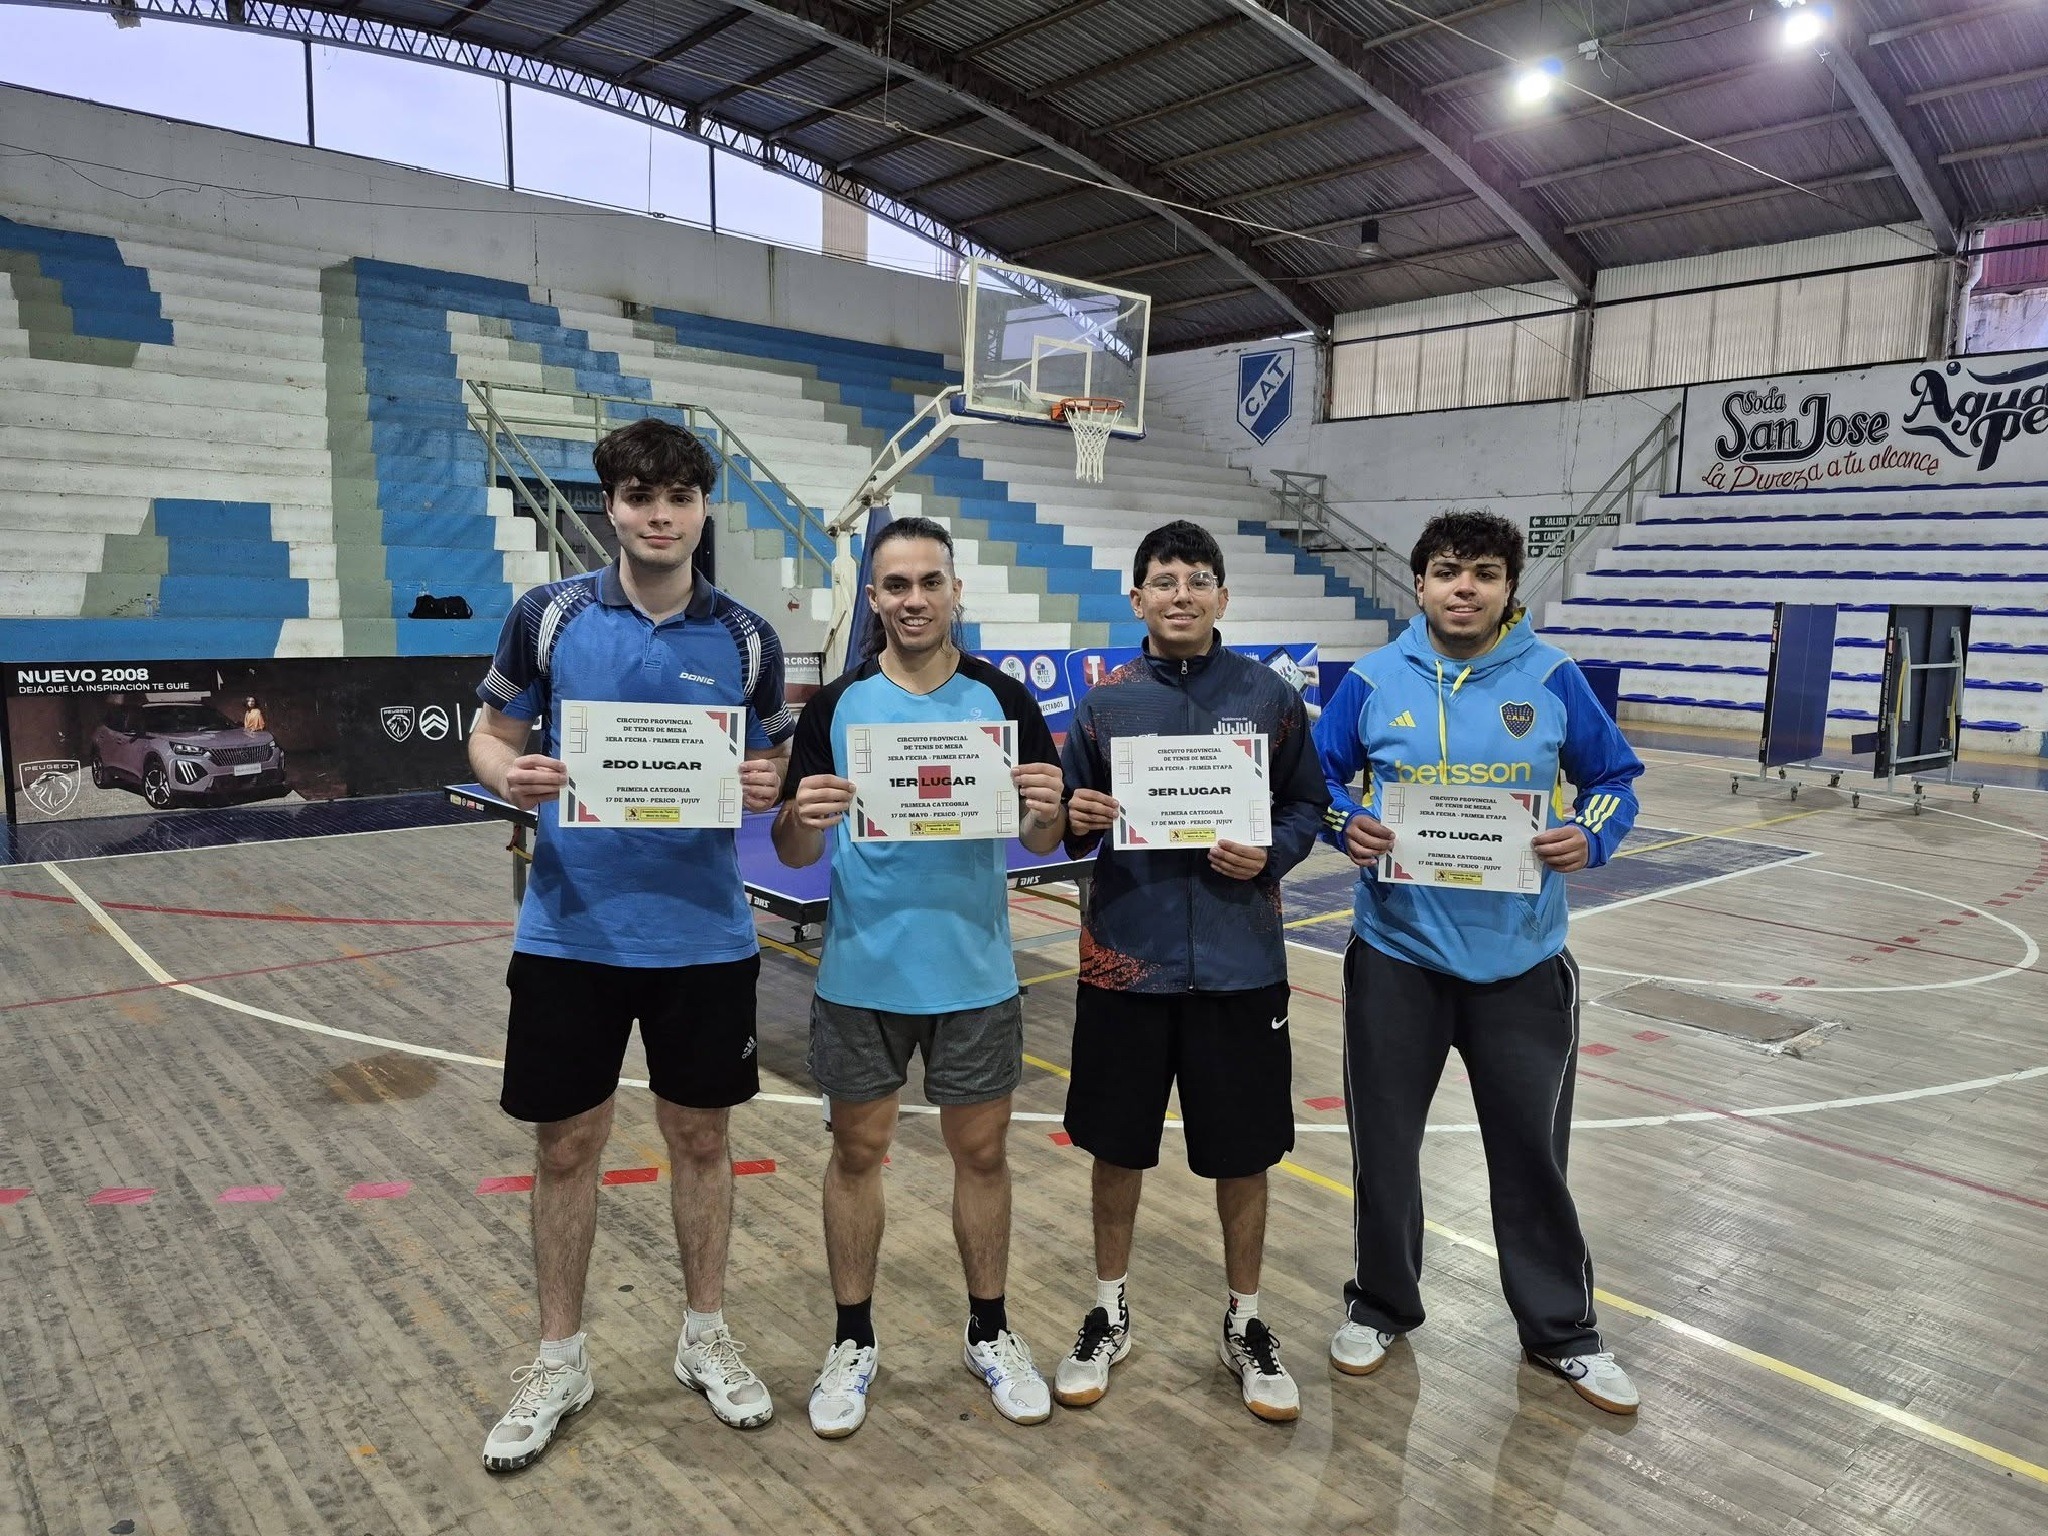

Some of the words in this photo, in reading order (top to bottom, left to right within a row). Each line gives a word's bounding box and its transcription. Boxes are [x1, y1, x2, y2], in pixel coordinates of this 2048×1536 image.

[1742, 386, 1787, 413] Soda
[1715, 391, 1800, 461] San
[1797, 392, 1889, 457] Jose
[1702, 462, 1726, 490] La
[1730, 462, 1823, 493] Pureza
[1827, 462, 1841, 477] a
[1843, 451, 1865, 473] tu
[1869, 445, 1940, 476] alcance
[1544, 516, 1567, 526] SALIDA
[18, 669, 97, 683] NUEVO
[102, 668, 149, 681] 2008
[679, 672, 715, 685] DONIC
[19, 683, 44, 694] DEJÁ
[46, 685, 69, 693] QUE
[71, 684, 84, 693] LA
[86, 682, 150, 692] INSPIRACIÓN
[166, 682, 190, 690] GUIE
[1041, 701, 1064, 712] ECTADOS
[24, 763, 75, 772] PEUGEOT
[602, 760, 639, 769] 2DO
[642, 760, 702, 770] LUGAR
[1395, 759, 1531, 785] betsson
[889, 778, 918, 788] 1ER
[922, 776, 976, 786] LUGAR
[1148, 788, 1178, 796] 3ER
[1181, 787, 1231, 796] LUGAR
[1417, 830, 1447, 838] 4TO
[1450, 831, 1502, 842] LUGAR
